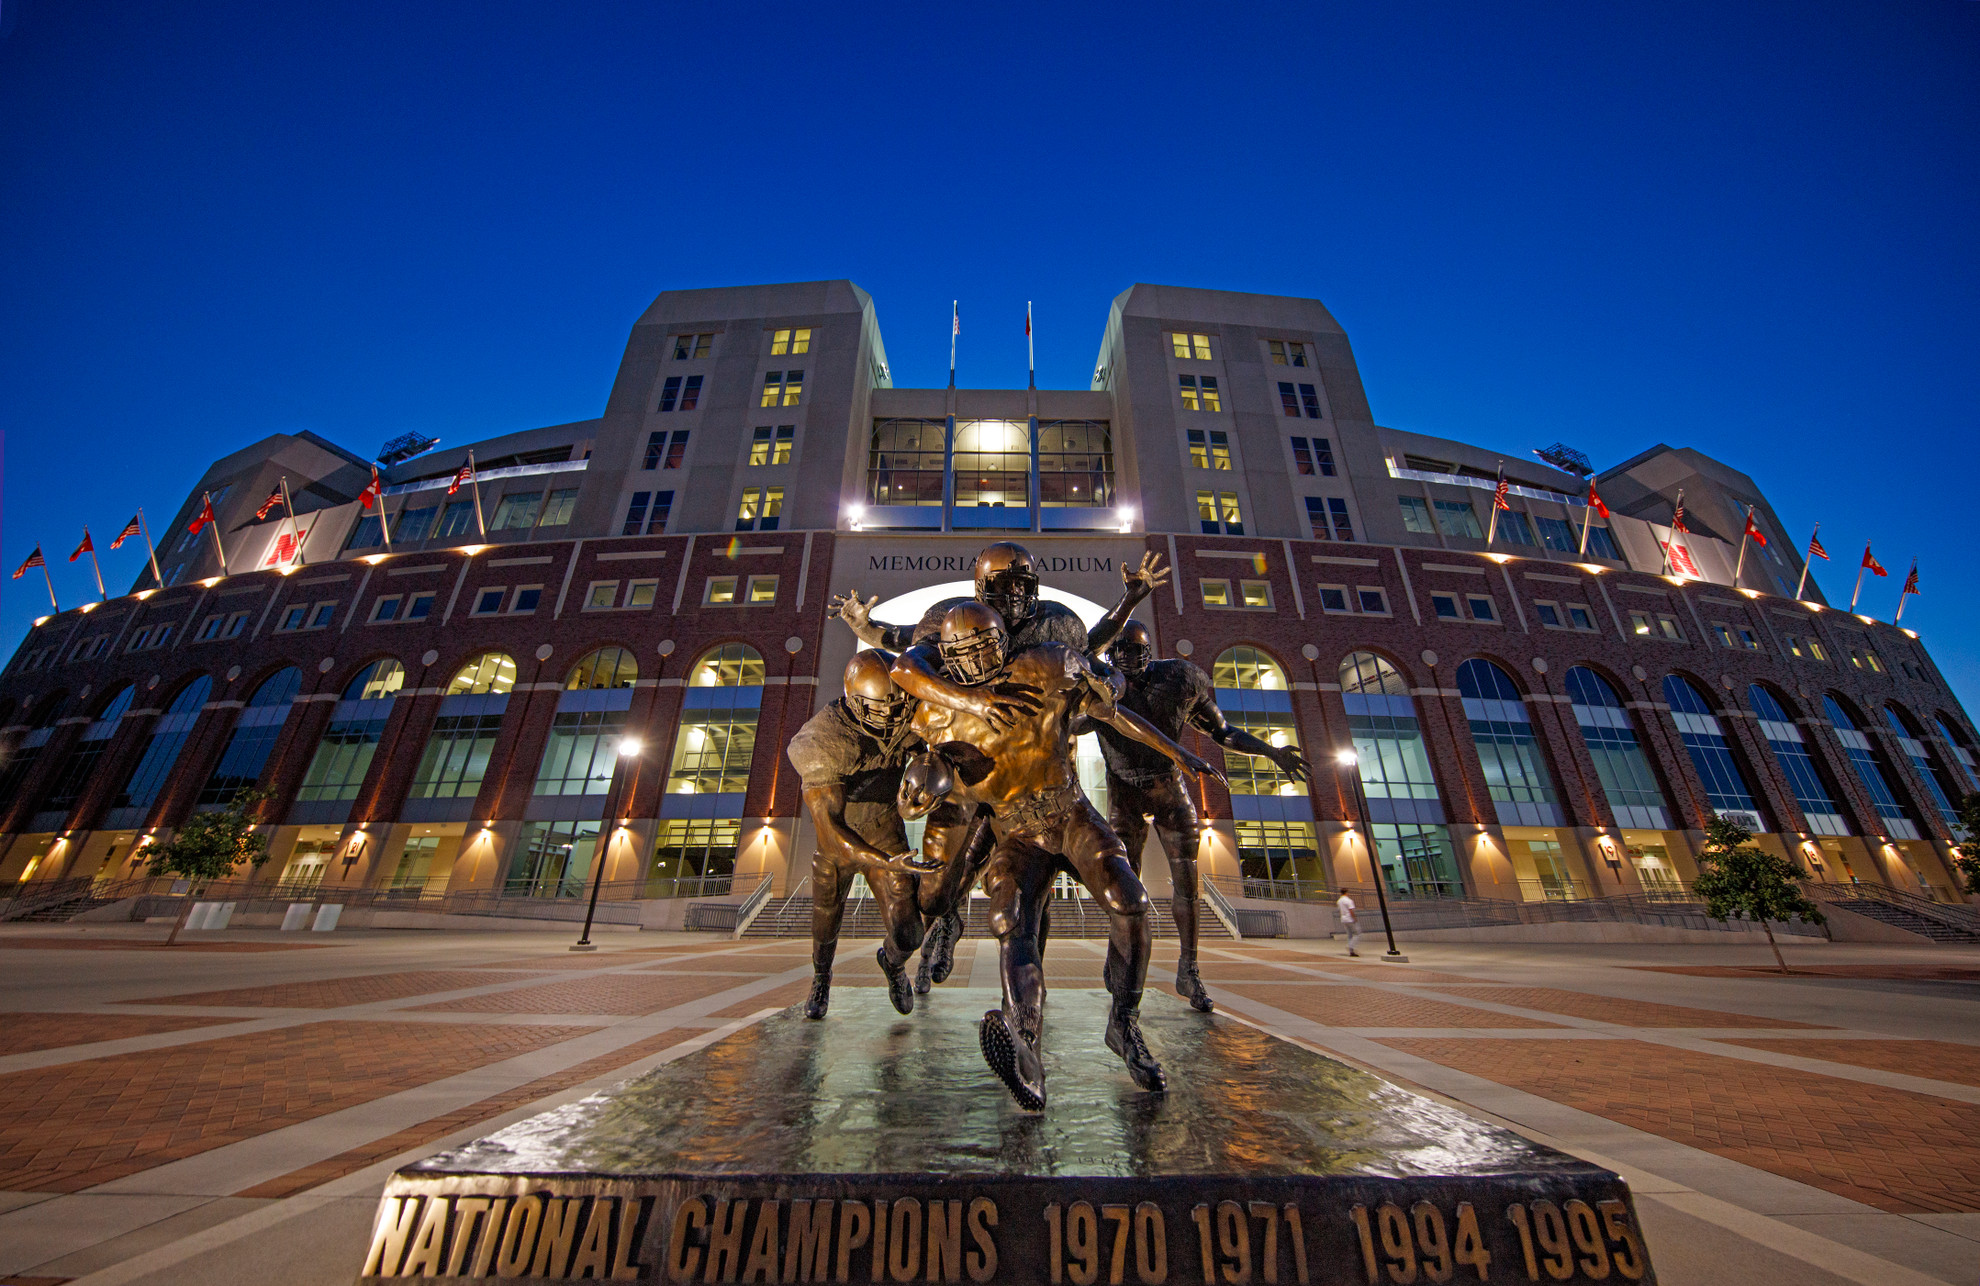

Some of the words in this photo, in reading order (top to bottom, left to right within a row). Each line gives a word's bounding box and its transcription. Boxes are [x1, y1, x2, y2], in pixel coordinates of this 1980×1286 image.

[265, 529, 307, 566] N
[868, 555, 978, 571] MEMORIA
[1035, 556, 1113, 572] ADIUM
[1660, 540, 1701, 577] N
[361, 1195, 640, 1280] NATIONAL
[668, 1196, 1000, 1284] CHAMPIONS
[1043, 1200, 1168, 1286] 1970
[1191, 1200, 1310, 1286] 1971
[1349, 1199, 1492, 1285] 1994
[1505, 1198, 1645, 1281] 1995
